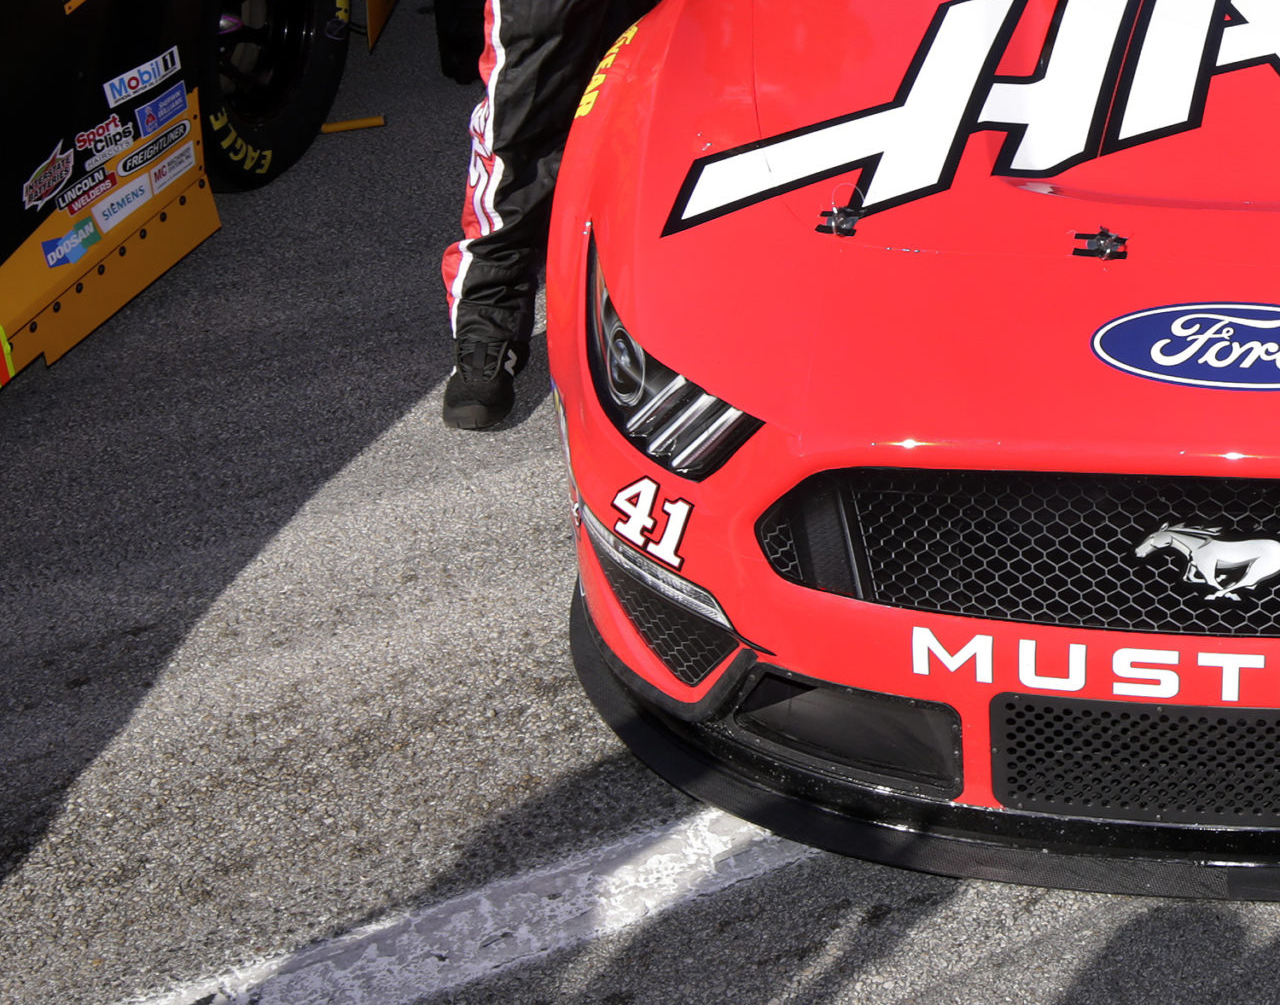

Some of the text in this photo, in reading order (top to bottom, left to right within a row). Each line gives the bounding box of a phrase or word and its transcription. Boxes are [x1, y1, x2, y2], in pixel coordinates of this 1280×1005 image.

[108, 60, 161, 100] Mobil
[74, 114, 121, 150] Sport
[93, 126, 134, 153] Clips
[124, 125, 186, 172] FREIGHTLINER
[208, 106, 273, 174] EAGLE
[58, 170, 105, 209] LINCOLN
[71, 179, 113, 212] WELDERS
[102, 184, 146, 221] SIEMENS
[46, 220, 96, 267] DOOSAN
[610, 474, 695, 573] 41
